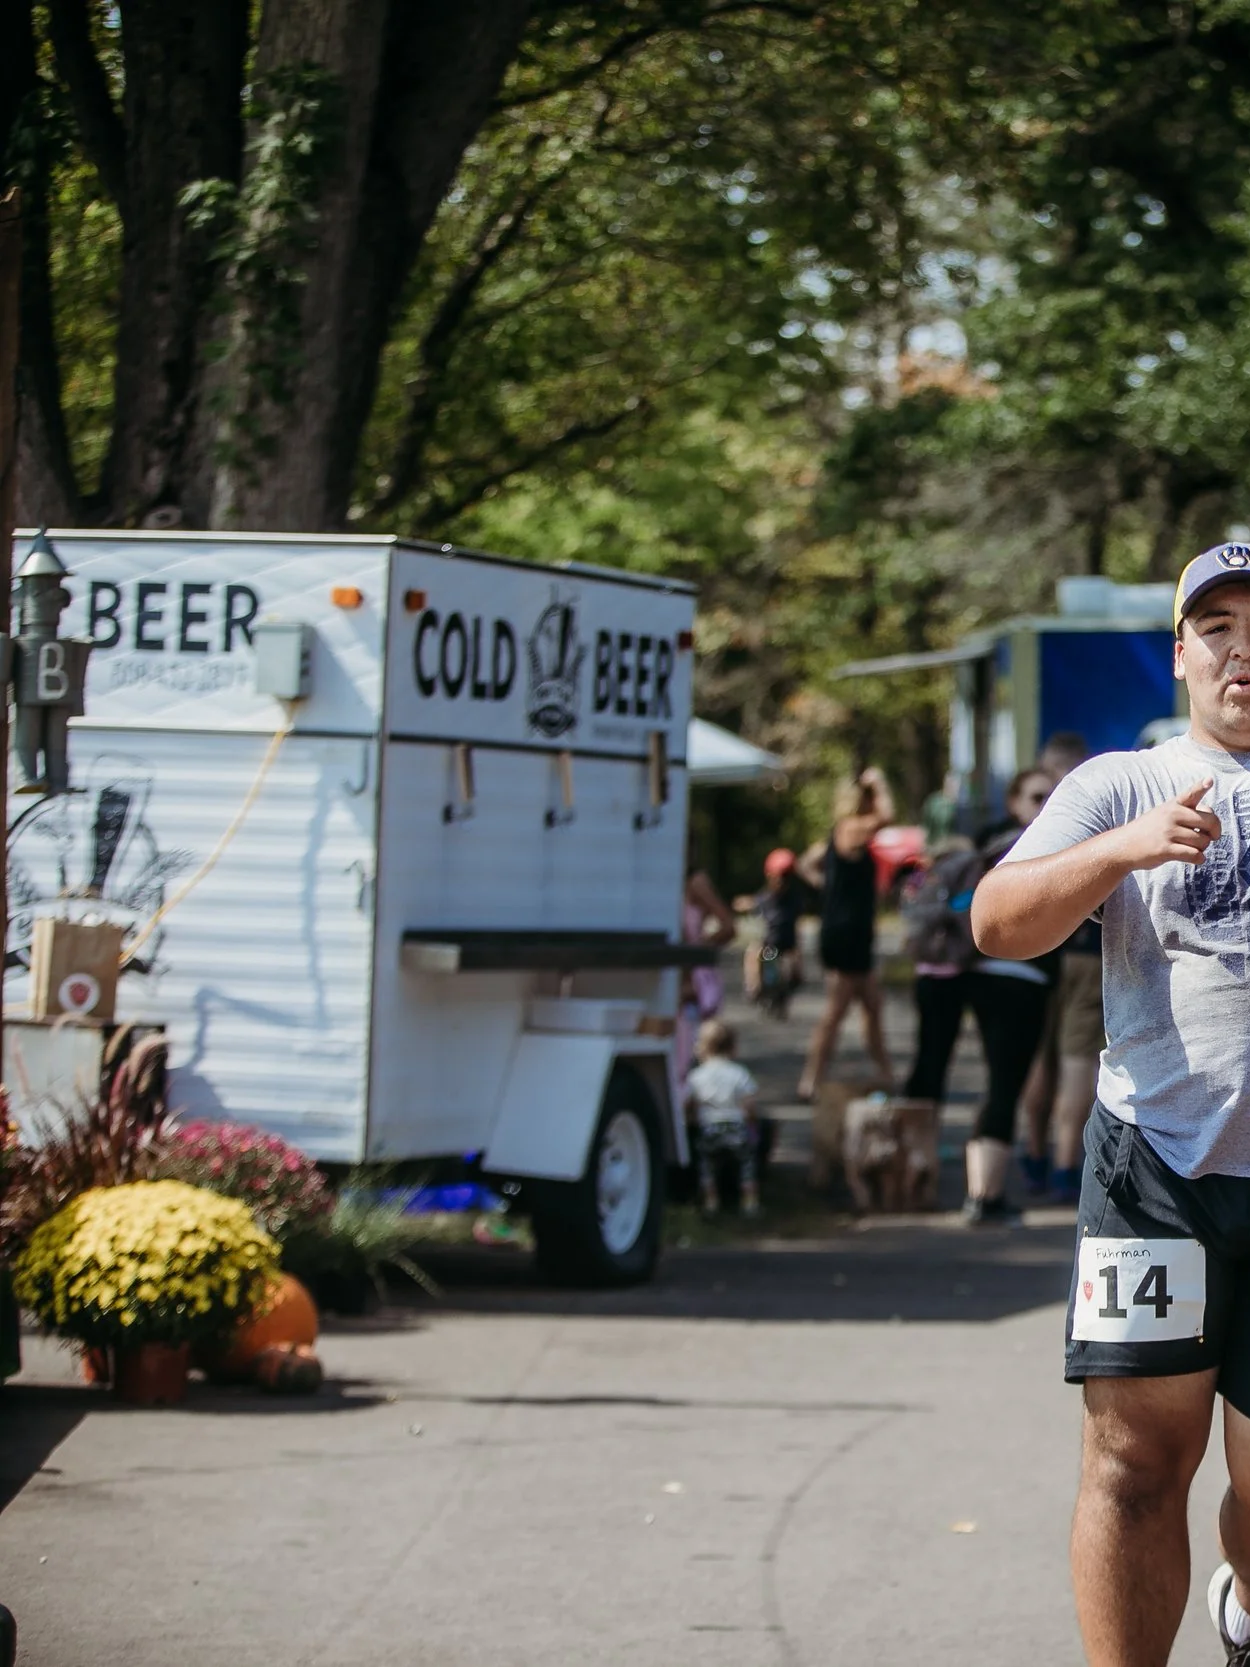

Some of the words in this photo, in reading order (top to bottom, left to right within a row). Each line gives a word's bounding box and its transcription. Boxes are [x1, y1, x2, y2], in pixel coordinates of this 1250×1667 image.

[89, 580, 258, 652] BEER
[38, 641, 69, 700] B
[414, 609, 517, 701] COLD
[594, 629, 673, 719] BEER
[1095, 1247, 1151, 1259] Fuhrman
[1098, 1265, 1173, 1318] 14
